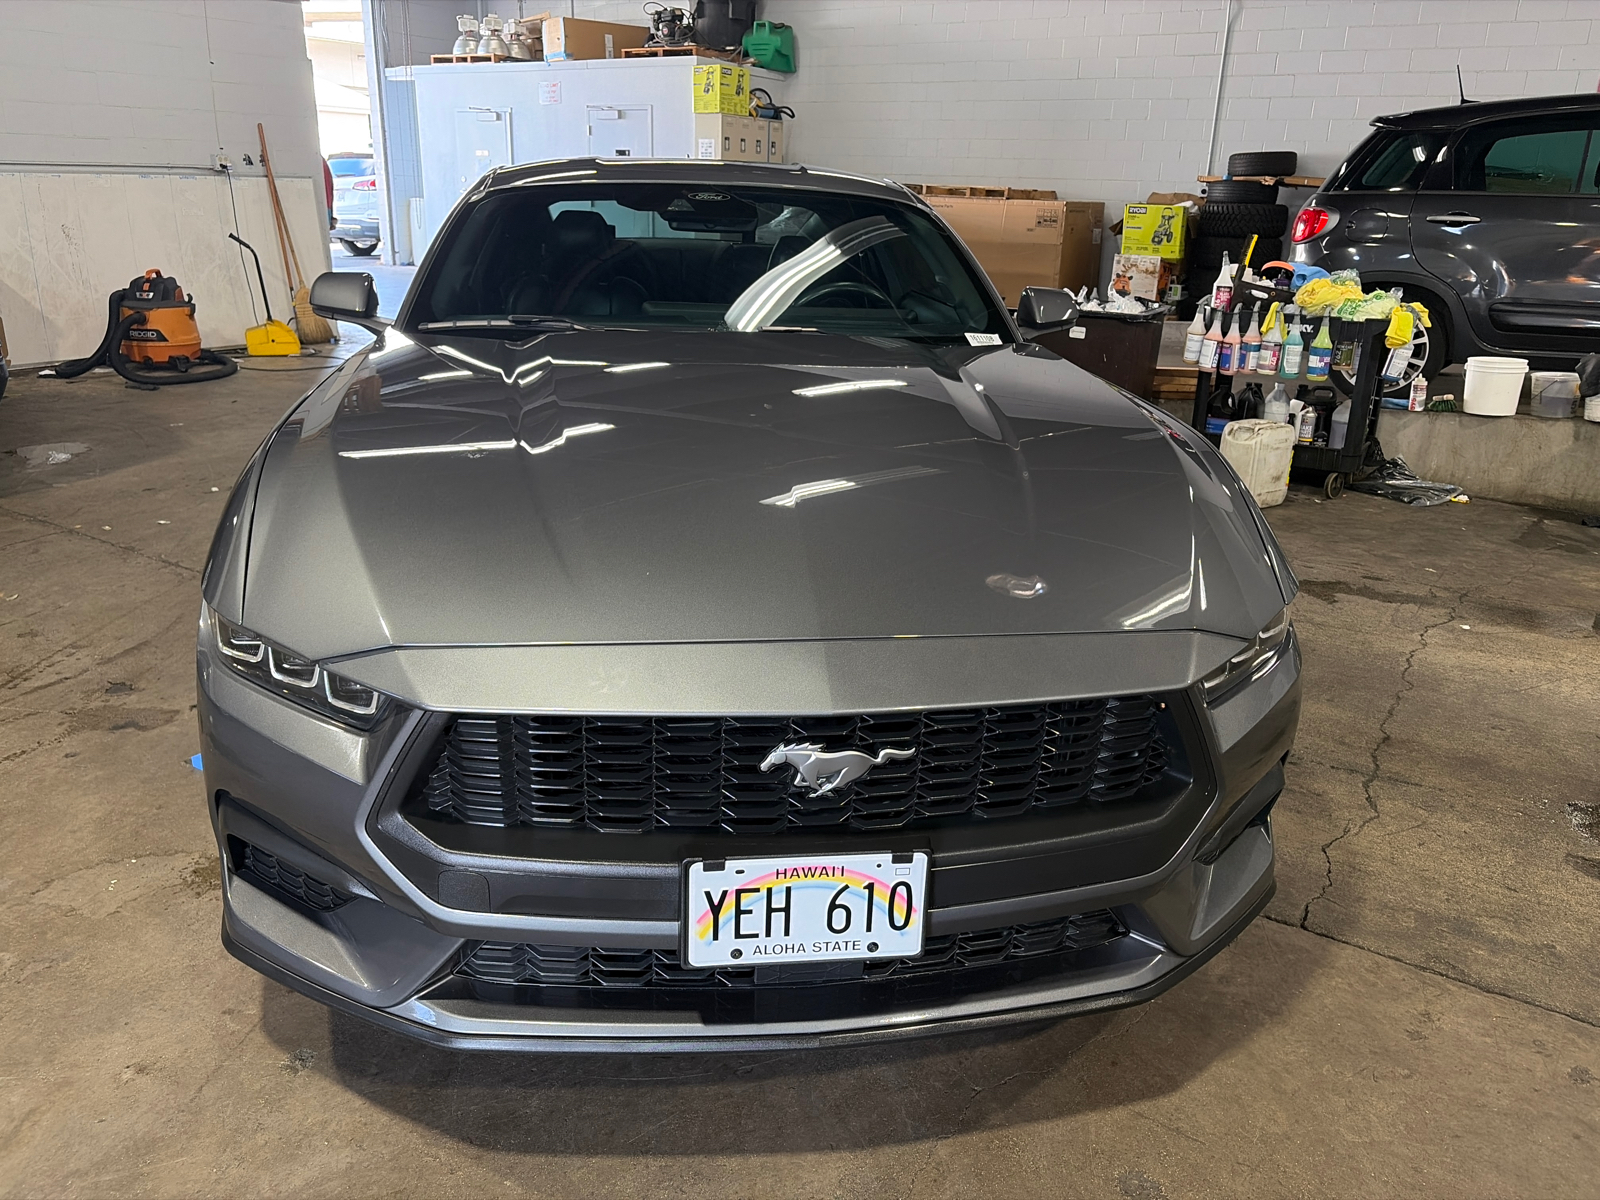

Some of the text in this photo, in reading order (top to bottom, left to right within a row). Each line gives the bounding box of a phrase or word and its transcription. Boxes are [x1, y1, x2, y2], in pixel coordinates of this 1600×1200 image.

[704, 881, 913, 942] YEH 610
[753, 940, 862, 956] ALOHA STATE
